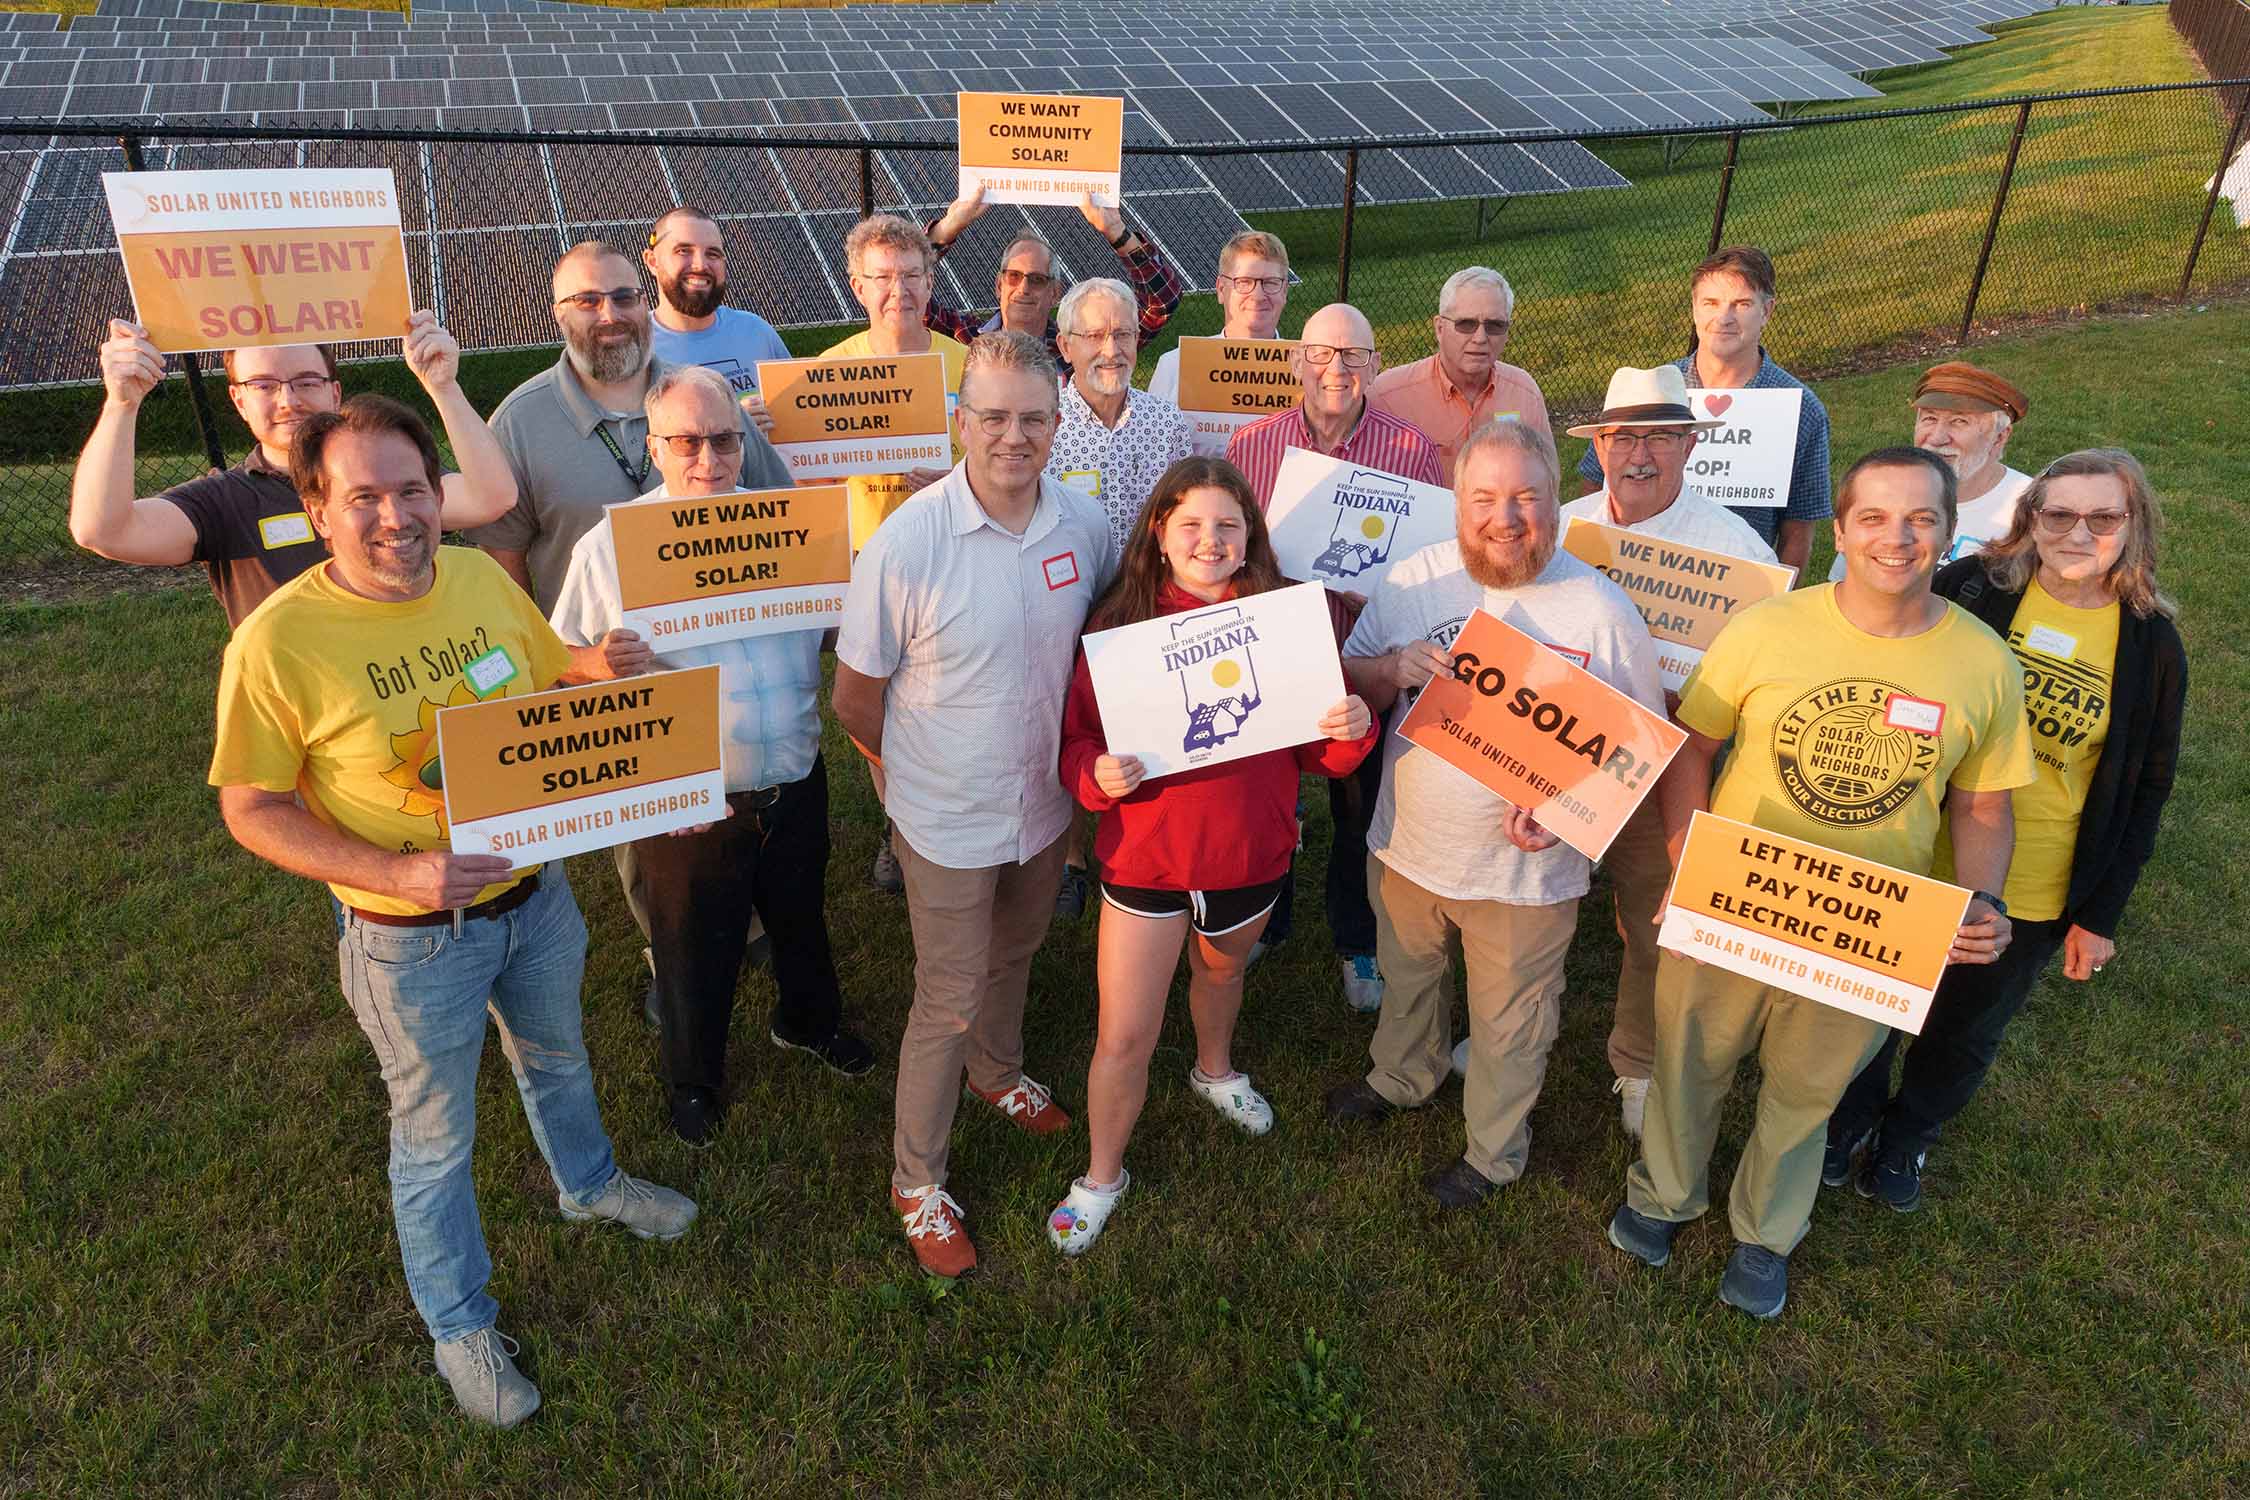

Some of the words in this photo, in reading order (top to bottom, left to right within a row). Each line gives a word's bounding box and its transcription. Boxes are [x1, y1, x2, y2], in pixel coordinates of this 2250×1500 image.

[1001, 102, 1026, 115] WE
[1030, 103, 1081, 118] WANT
[989, 124, 1092, 141] COMMUNITY
[1011, 148, 1069, 162] SOLAR!
[980, 178, 1012, 190] SOLAR
[1015, 180, 1050, 192] UNITED
[147, 193, 209, 213] SOLAR
[216, 191, 284, 210] UNITED
[289, 190, 387, 208] NEIGHBORS
[155, 246, 236, 280] WE
[241, 241, 375, 275] WENT
[201, 300, 364, 338] SOLAR!
[1224, 347, 1249, 361] WE
[1255, 348, 1290, 362] WAN
[806, 368, 835, 383] WE
[840, 364, 897, 382] WANT
[1209, 370, 1303, 386] COMMUNI
[795, 389, 913, 409] COMMUNITY
[1231, 393, 1292, 408] SOLAR!
[825, 415, 890, 432] SOLAR!
[1197, 422, 1231, 434] SOLAR
[1696, 428, 1751, 444] OLAR
[793, 454, 829, 467] SOLAR
[833, 450, 873, 463] UNITED
[877, 446, 942, 461] NEIGHBORS
[1686, 460, 1731, 476] -OP!
[868, 484, 890, 493] SOLAR
[1336, 483, 1352, 491] KEEP
[1381, 490, 1407, 499] SHINING
[1706, 486, 1775, 499] NEIGHBORS
[672, 508, 709, 528] WE
[716, 500, 790, 523] WANT
[1333, 490, 1411, 516] INDIANA
[658, 529, 809, 562] COMMUNITY
[1619, 539, 1654, 563] WE
[1659, 550, 1731, 582] WANT
[695, 562, 779, 588] SOLAR!
[653, 616, 700, 636] SOLAR
[705, 607, 756, 628] UNITED
[761, 598, 843, 619] NEIGHBORS
[1161, 641, 1180, 653] KEEP
[1181, 636, 1195, 646] THE
[1197, 631, 1213, 641] SUN
[1214, 619, 1245, 634] SHINING
[1164, 625, 1260, 672] INDIANA
[1434, 625, 1461, 646] TH
[366, 656, 416, 700] Got
[420, 626, 490, 683] Solar?
[2024, 669, 2105, 719] OLAR
[517, 703, 561, 728] WE
[569, 688, 654, 719] WANT
[1452, 652, 1506, 697] GO
[1506, 687, 1652, 791] SOLAR!
[1779, 710, 1807, 746] LET
[1809, 686, 1858, 712] THE
[2024, 694, 2095, 730] ENERGY
[498, 716, 674, 766] COMMUNITY
[1819, 725, 1864, 745] SOLAR
[1814, 740, 1865, 760] UNITED
[542, 757, 639, 793] SOLAR!
[1441, 718, 1481, 751] SOLAR
[1482, 741, 1526, 778] UNITED
[1526, 771, 1597, 825] NEIGHBORS
[1810, 754, 1889, 781] NEIGHBORS
[1783, 766, 1811, 805] YOUR
[1810, 802, 1882, 821] ELECTRIC
[1884, 784, 1912, 808] BILL
[491, 825, 548, 852] SOLAR
[554, 809, 613, 838] UNITED
[620, 789, 710, 825] NEIGHBORS
[1740, 838, 1785, 865] LET
[1793, 852, 1843, 883] THE
[1848, 871, 1910, 903] SUN
[1745, 872, 1800, 900] PAY
[1807, 889, 1882, 929] YOUR
[1709, 891, 1828, 943] ELECTRIC
[1833, 932, 1902, 967] BILL!
[1694, 929, 1745, 958] SOLAR
[1750, 947, 1807, 978] UNITED
[1812, 968, 1911, 1014] NEIGHBORS
